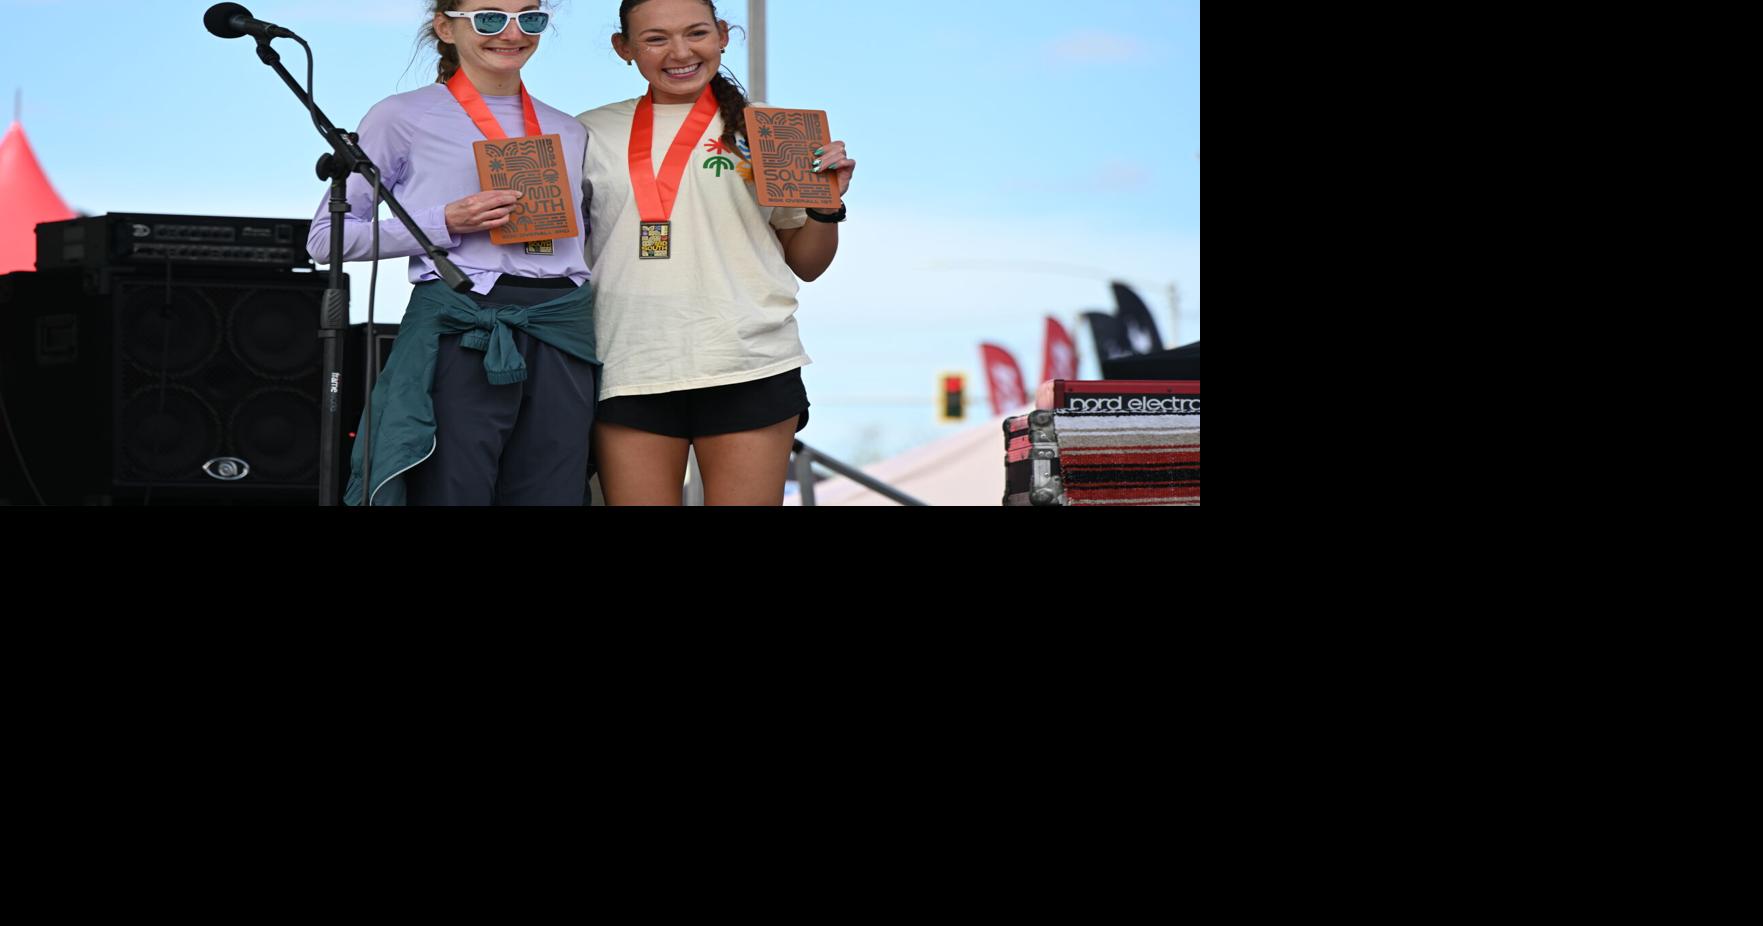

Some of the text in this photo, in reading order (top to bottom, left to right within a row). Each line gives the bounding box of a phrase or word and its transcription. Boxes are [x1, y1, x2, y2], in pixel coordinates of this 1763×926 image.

[529, 185, 561, 200] MID
[510, 199, 565, 215] OUTH
[1070, 396, 1122, 412] nord
